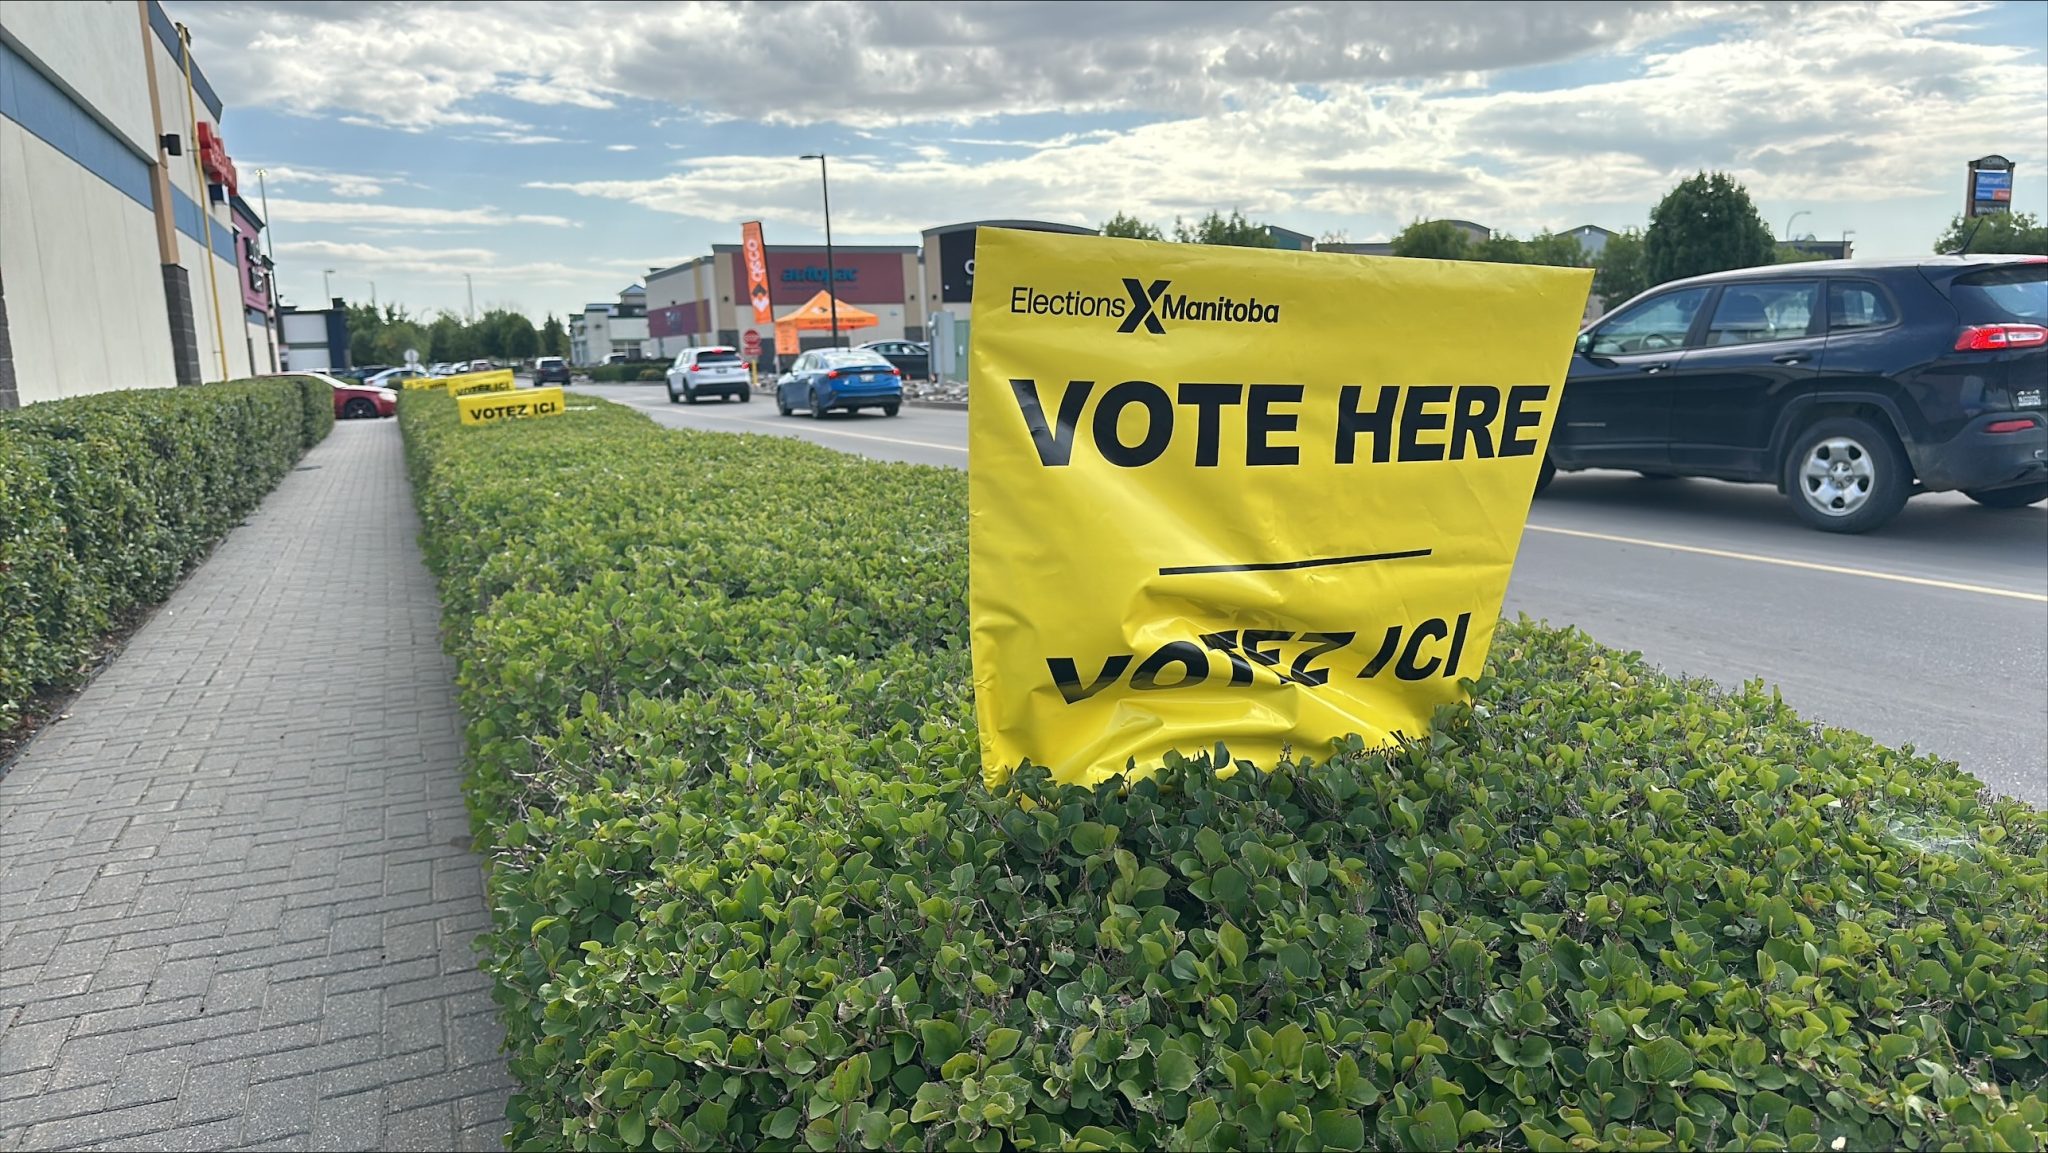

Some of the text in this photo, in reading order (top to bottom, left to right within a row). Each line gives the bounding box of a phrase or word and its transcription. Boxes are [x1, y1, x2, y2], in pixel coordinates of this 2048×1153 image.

[1012, 287, 1126, 318] Elections
[1162, 293, 1280, 324] Manitoba
[470, 402, 556, 421] VOTEZ ICI
[1009, 379, 1551, 468] VOTE HERE
[1046, 613, 1472, 705] VOTEZ ICI
